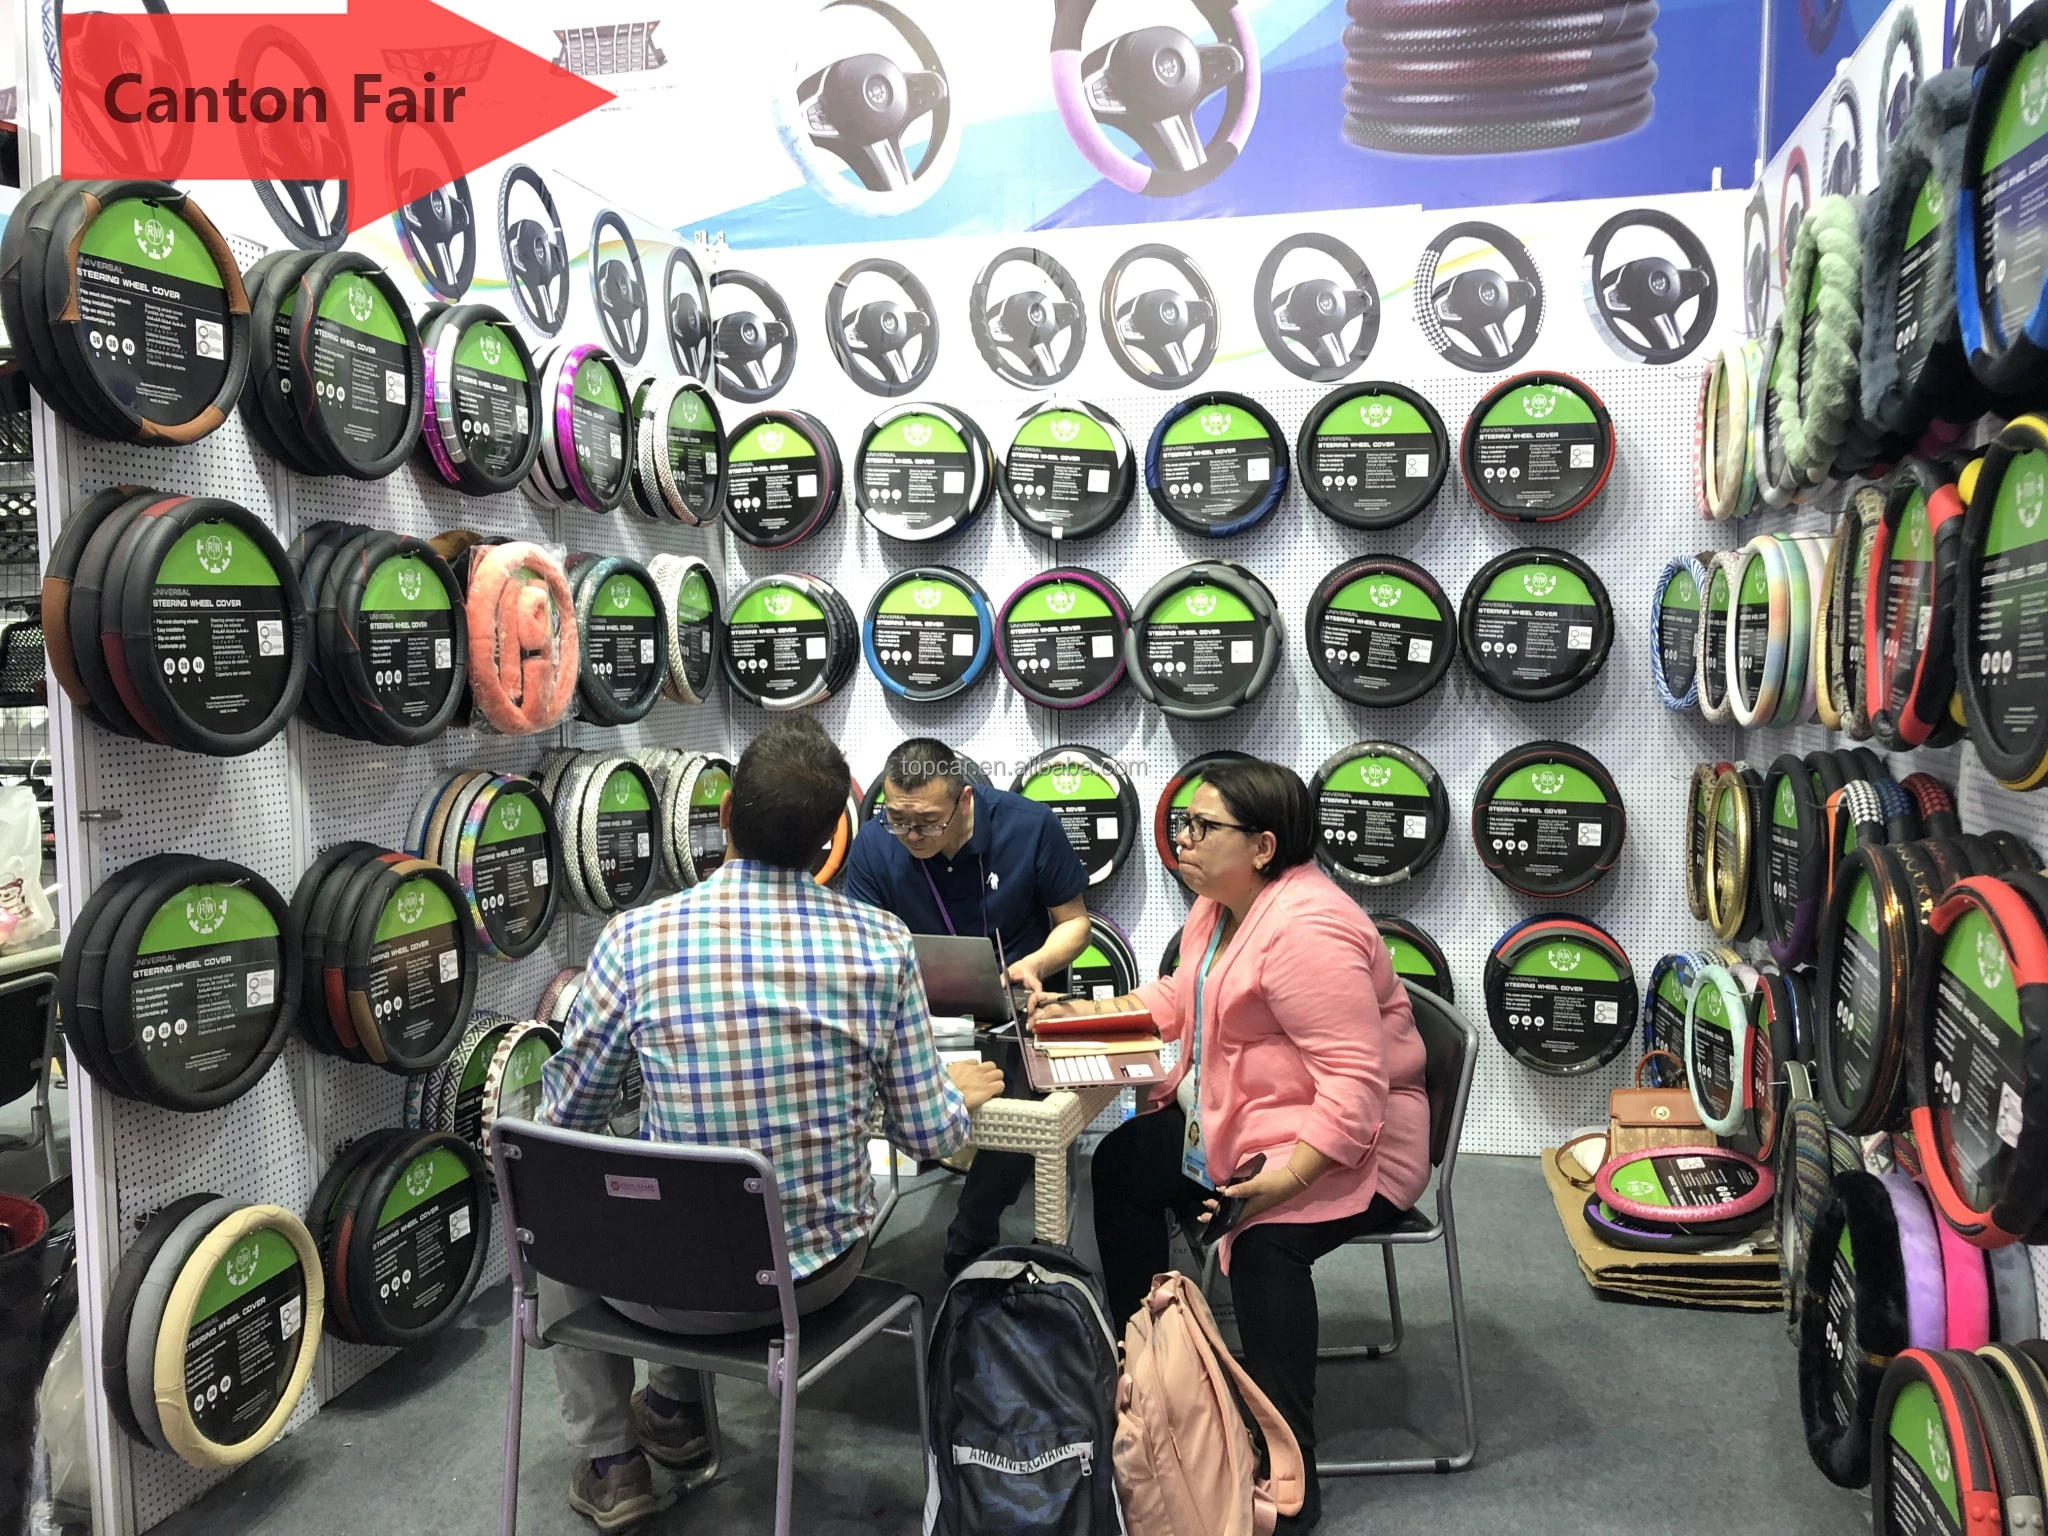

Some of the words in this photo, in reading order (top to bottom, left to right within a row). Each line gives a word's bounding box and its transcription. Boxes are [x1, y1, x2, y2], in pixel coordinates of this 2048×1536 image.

[76, 267, 120, 286] STEERING
[122, 278, 150, 292] WHEEL
[152, 286, 181, 300] COVER
[1479, 432, 1511, 440] STEERING
[152, 599, 188, 608] STEERING
[190, 599, 214, 608] WHEEL
[216, 599, 242, 608] COVER
[1324, 615, 1355, 624] STEERING
[370, 622, 394, 630] STEERING
[1320, 797, 1349, 805] STEERING
[371, 952, 390, 963] TEERING
[132, 965, 173, 978] STEERING
[175, 961, 202, 972] WHEEL
[204, 955, 232, 966] COVER
[1504, 981, 1536, 989] STEERING
[372, 1229, 400, 1251] STEERING
[400, 1218, 419, 1233] WHEEL
[419, 1205, 439, 1221] COVER
[218, 1313, 241, 1331] WHEEL
[242, 1296, 266, 1316] COVER
[969, 1448, 1017, 1471] ARMANI
